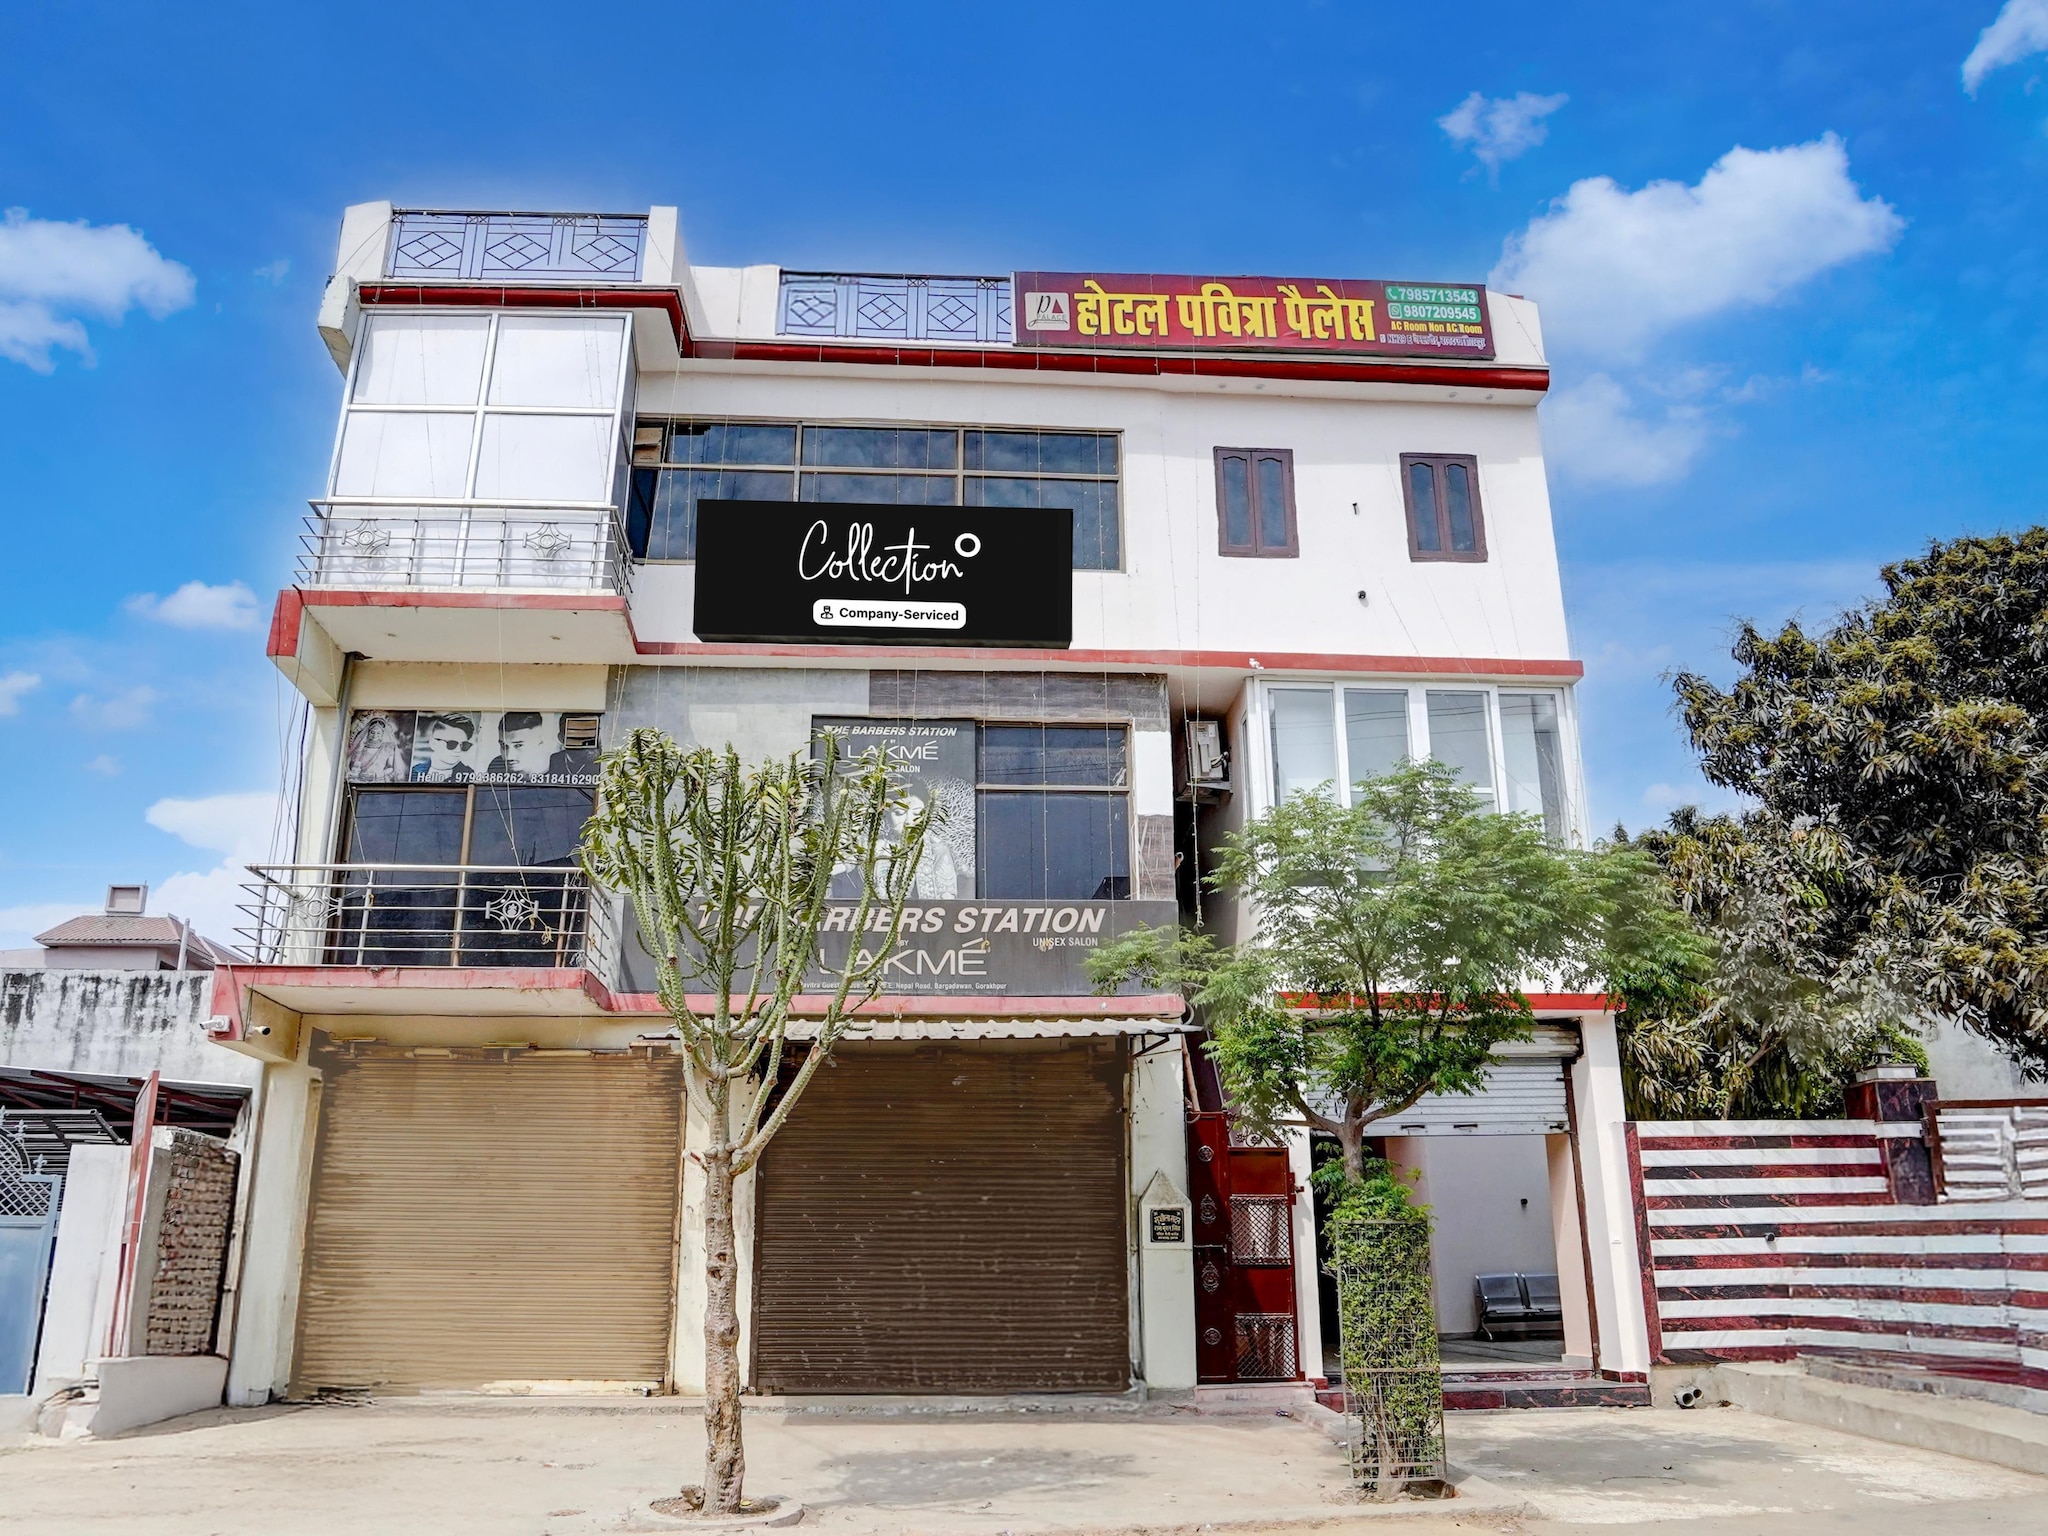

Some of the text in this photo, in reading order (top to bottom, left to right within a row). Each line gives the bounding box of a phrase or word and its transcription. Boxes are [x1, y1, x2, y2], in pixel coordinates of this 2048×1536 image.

[1398, 288, 1476, 303] 7985713543
[1074, 279, 1376, 341] होटल पवित्रा पैलेस
[1403, 305, 1477, 319] 9807209545
[1391, 321, 1402, 331] AC
[1404, 321, 1427, 332] Room
[1428, 322, 1445, 332] Non
[1446, 323, 1457, 333] AC
[798, 519, 964, 595] Collection
[839, 607, 959, 622] Company-Serviced
[852, 725, 906, 736] BARBERS
[908, 726, 958, 737] STATION
[847, 740, 939, 760] LAKMÉ
[895, 765, 921, 773] SALON
[417, 772, 444, 782] Hello
[774, 906, 946, 933] RBERS
[954, 907, 1106, 934] STATION
[900, 937, 1098, 948] BY UNISEX SALON
[818, 937, 988, 976] LAKMÉ
[822, 981, 841, 989] Guest
[896, 982, 914, 991] Nepal
[934, 983, 973, 991] Bargadawan,
[975, 983, 1008, 991] Gorakhpur
